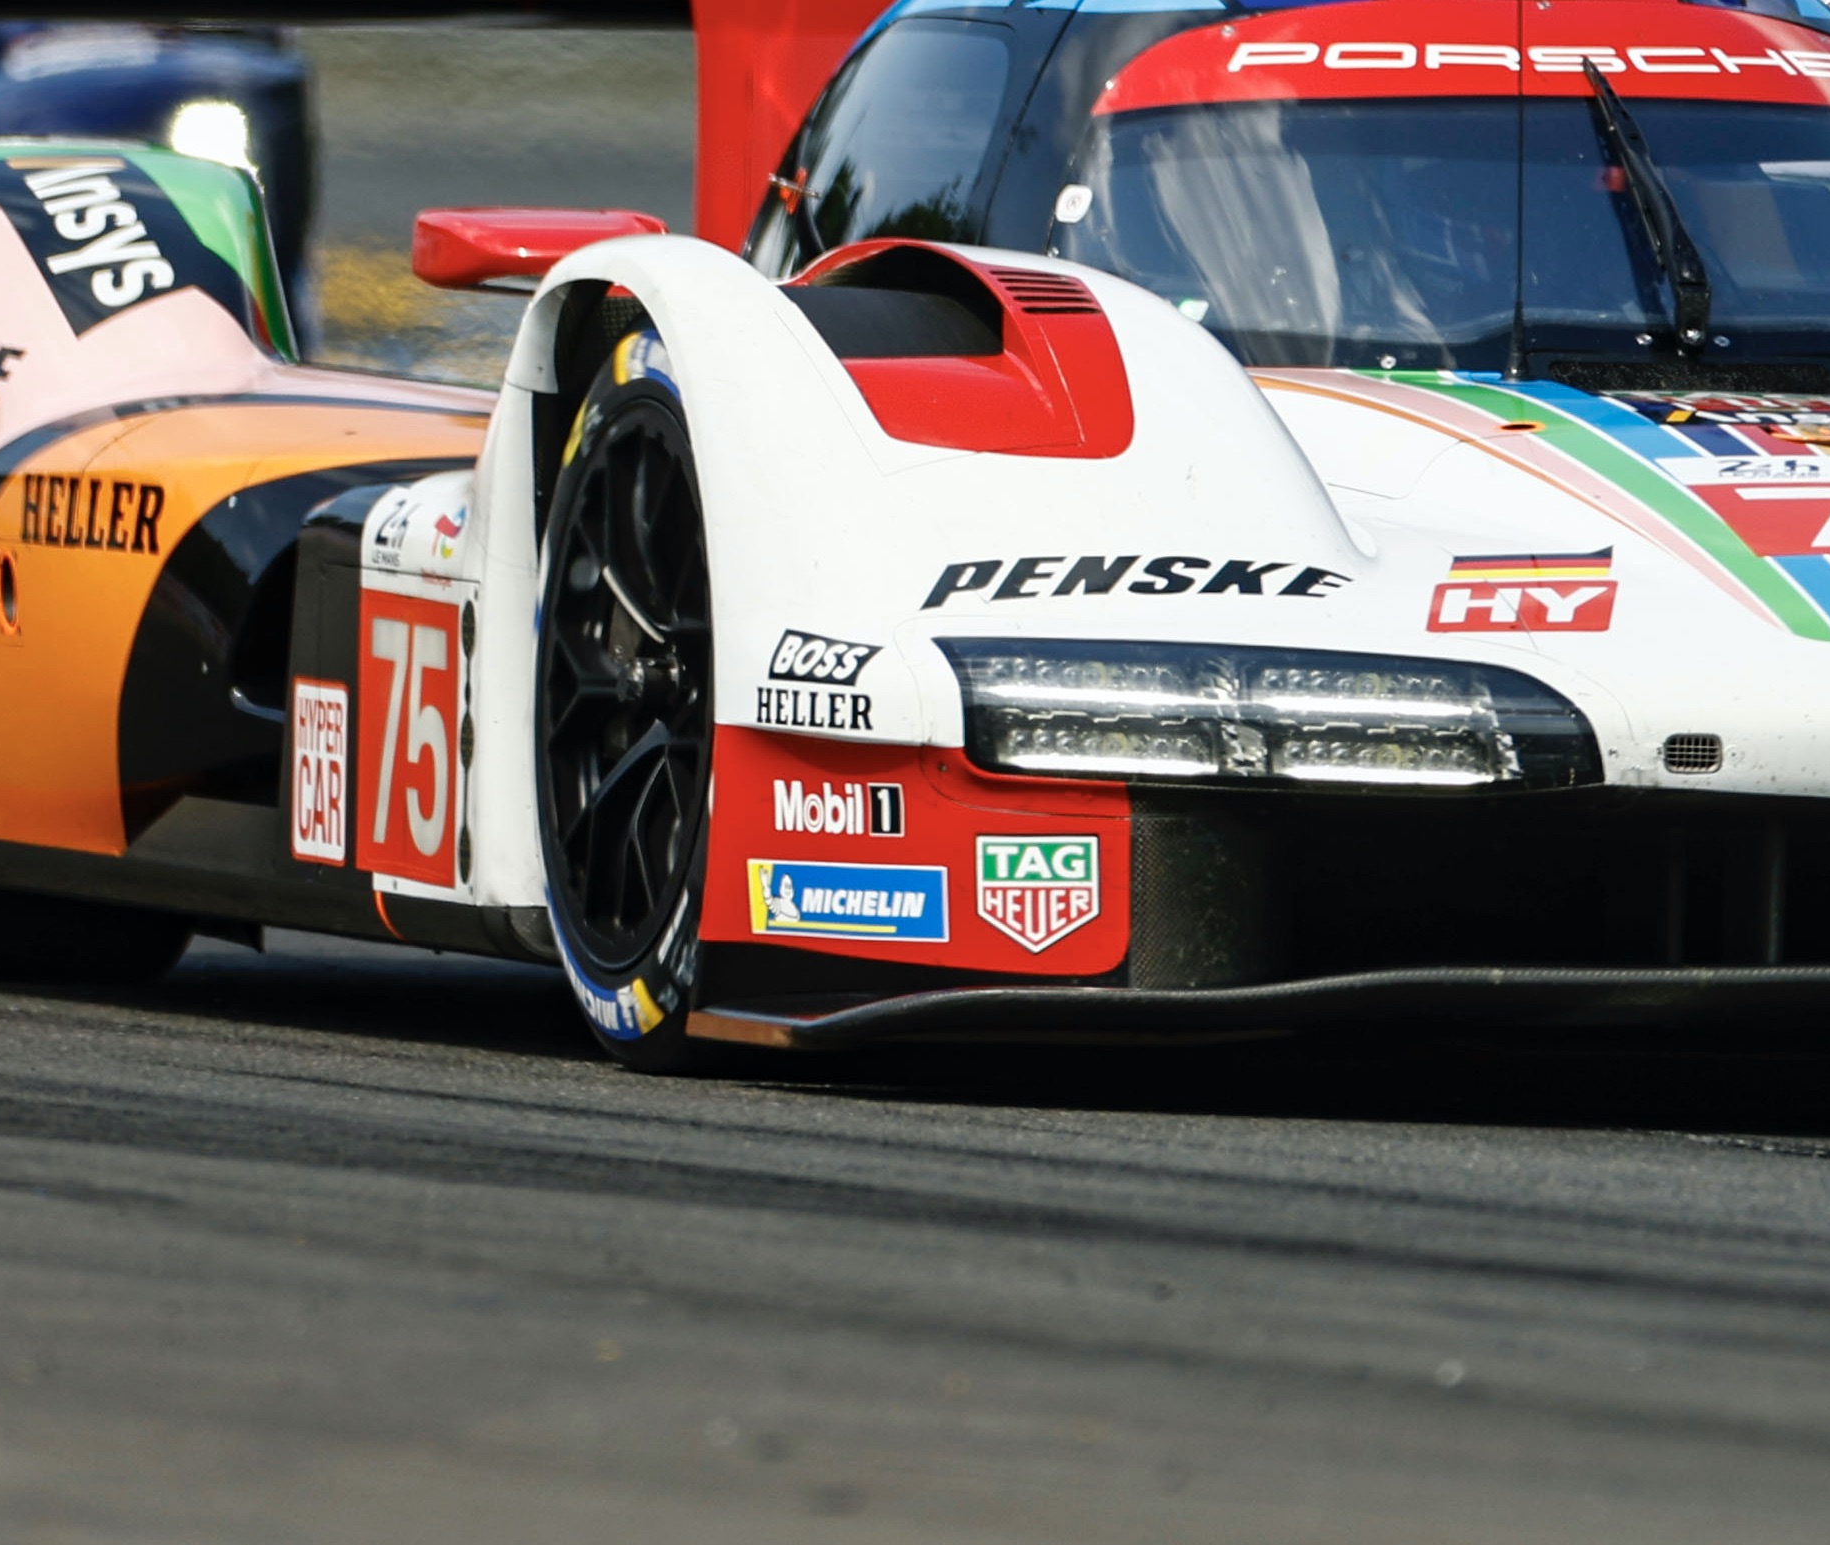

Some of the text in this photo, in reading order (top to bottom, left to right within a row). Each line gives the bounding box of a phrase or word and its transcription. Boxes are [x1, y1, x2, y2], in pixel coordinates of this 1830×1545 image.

[20, 473, 165, 555] HELLER
[921, 555, 1353, 609] PENSKE
[1438, 585, 1607, 625] HY
[771, 632, 871, 684] BOSS
[298, 695, 344, 756] HYPER
[755, 687, 873, 731] HELLER
[372, 617, 450, 856] 75
[296, 757, 343, 849] CAR
[773, 779, 864, 835] Mobil
[985, 843, 1089, 882] TAG
[800, 885, 926, 918] MICHELIN
[984, 887, 1091, 940] HEUER
